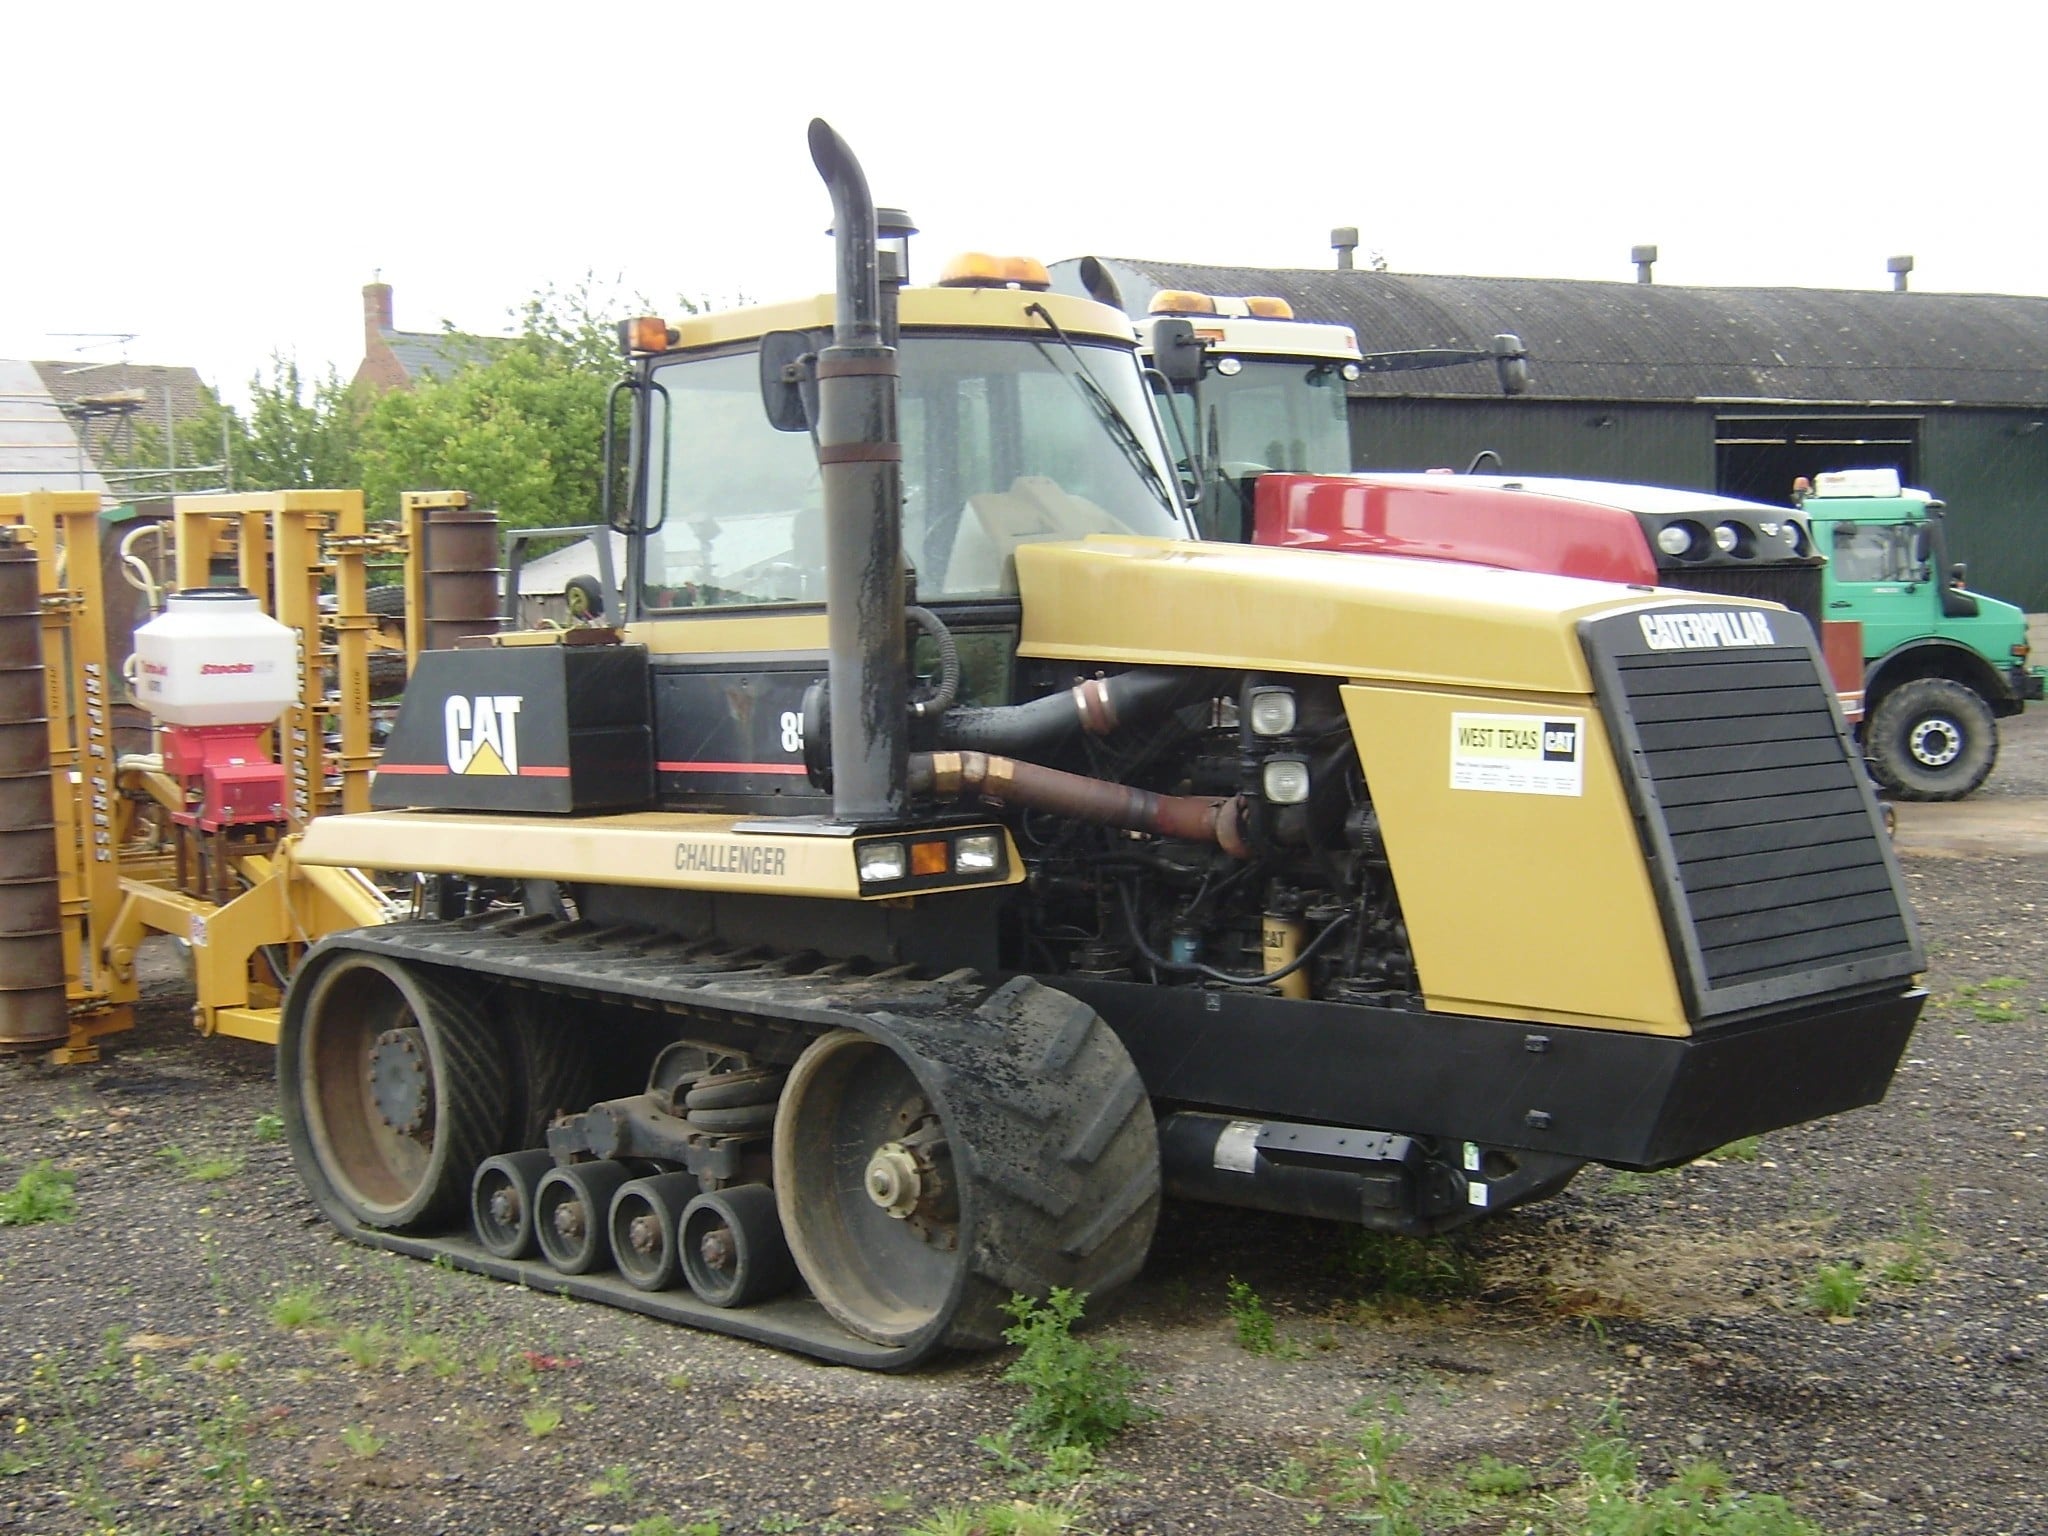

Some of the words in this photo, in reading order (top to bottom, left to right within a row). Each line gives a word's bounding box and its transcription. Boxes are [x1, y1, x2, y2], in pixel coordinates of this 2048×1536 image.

[1638, 611, 1775, 650] CATERPILLAR
[445, 695, 523, 776] CAT
[1458, 727, 1494, 747] WEST
[1498, 728, 1538, 750] TEXAS
[1545, 732, 1576, 752] CAT
[675, 842, 786, 876] CHALLENGER
